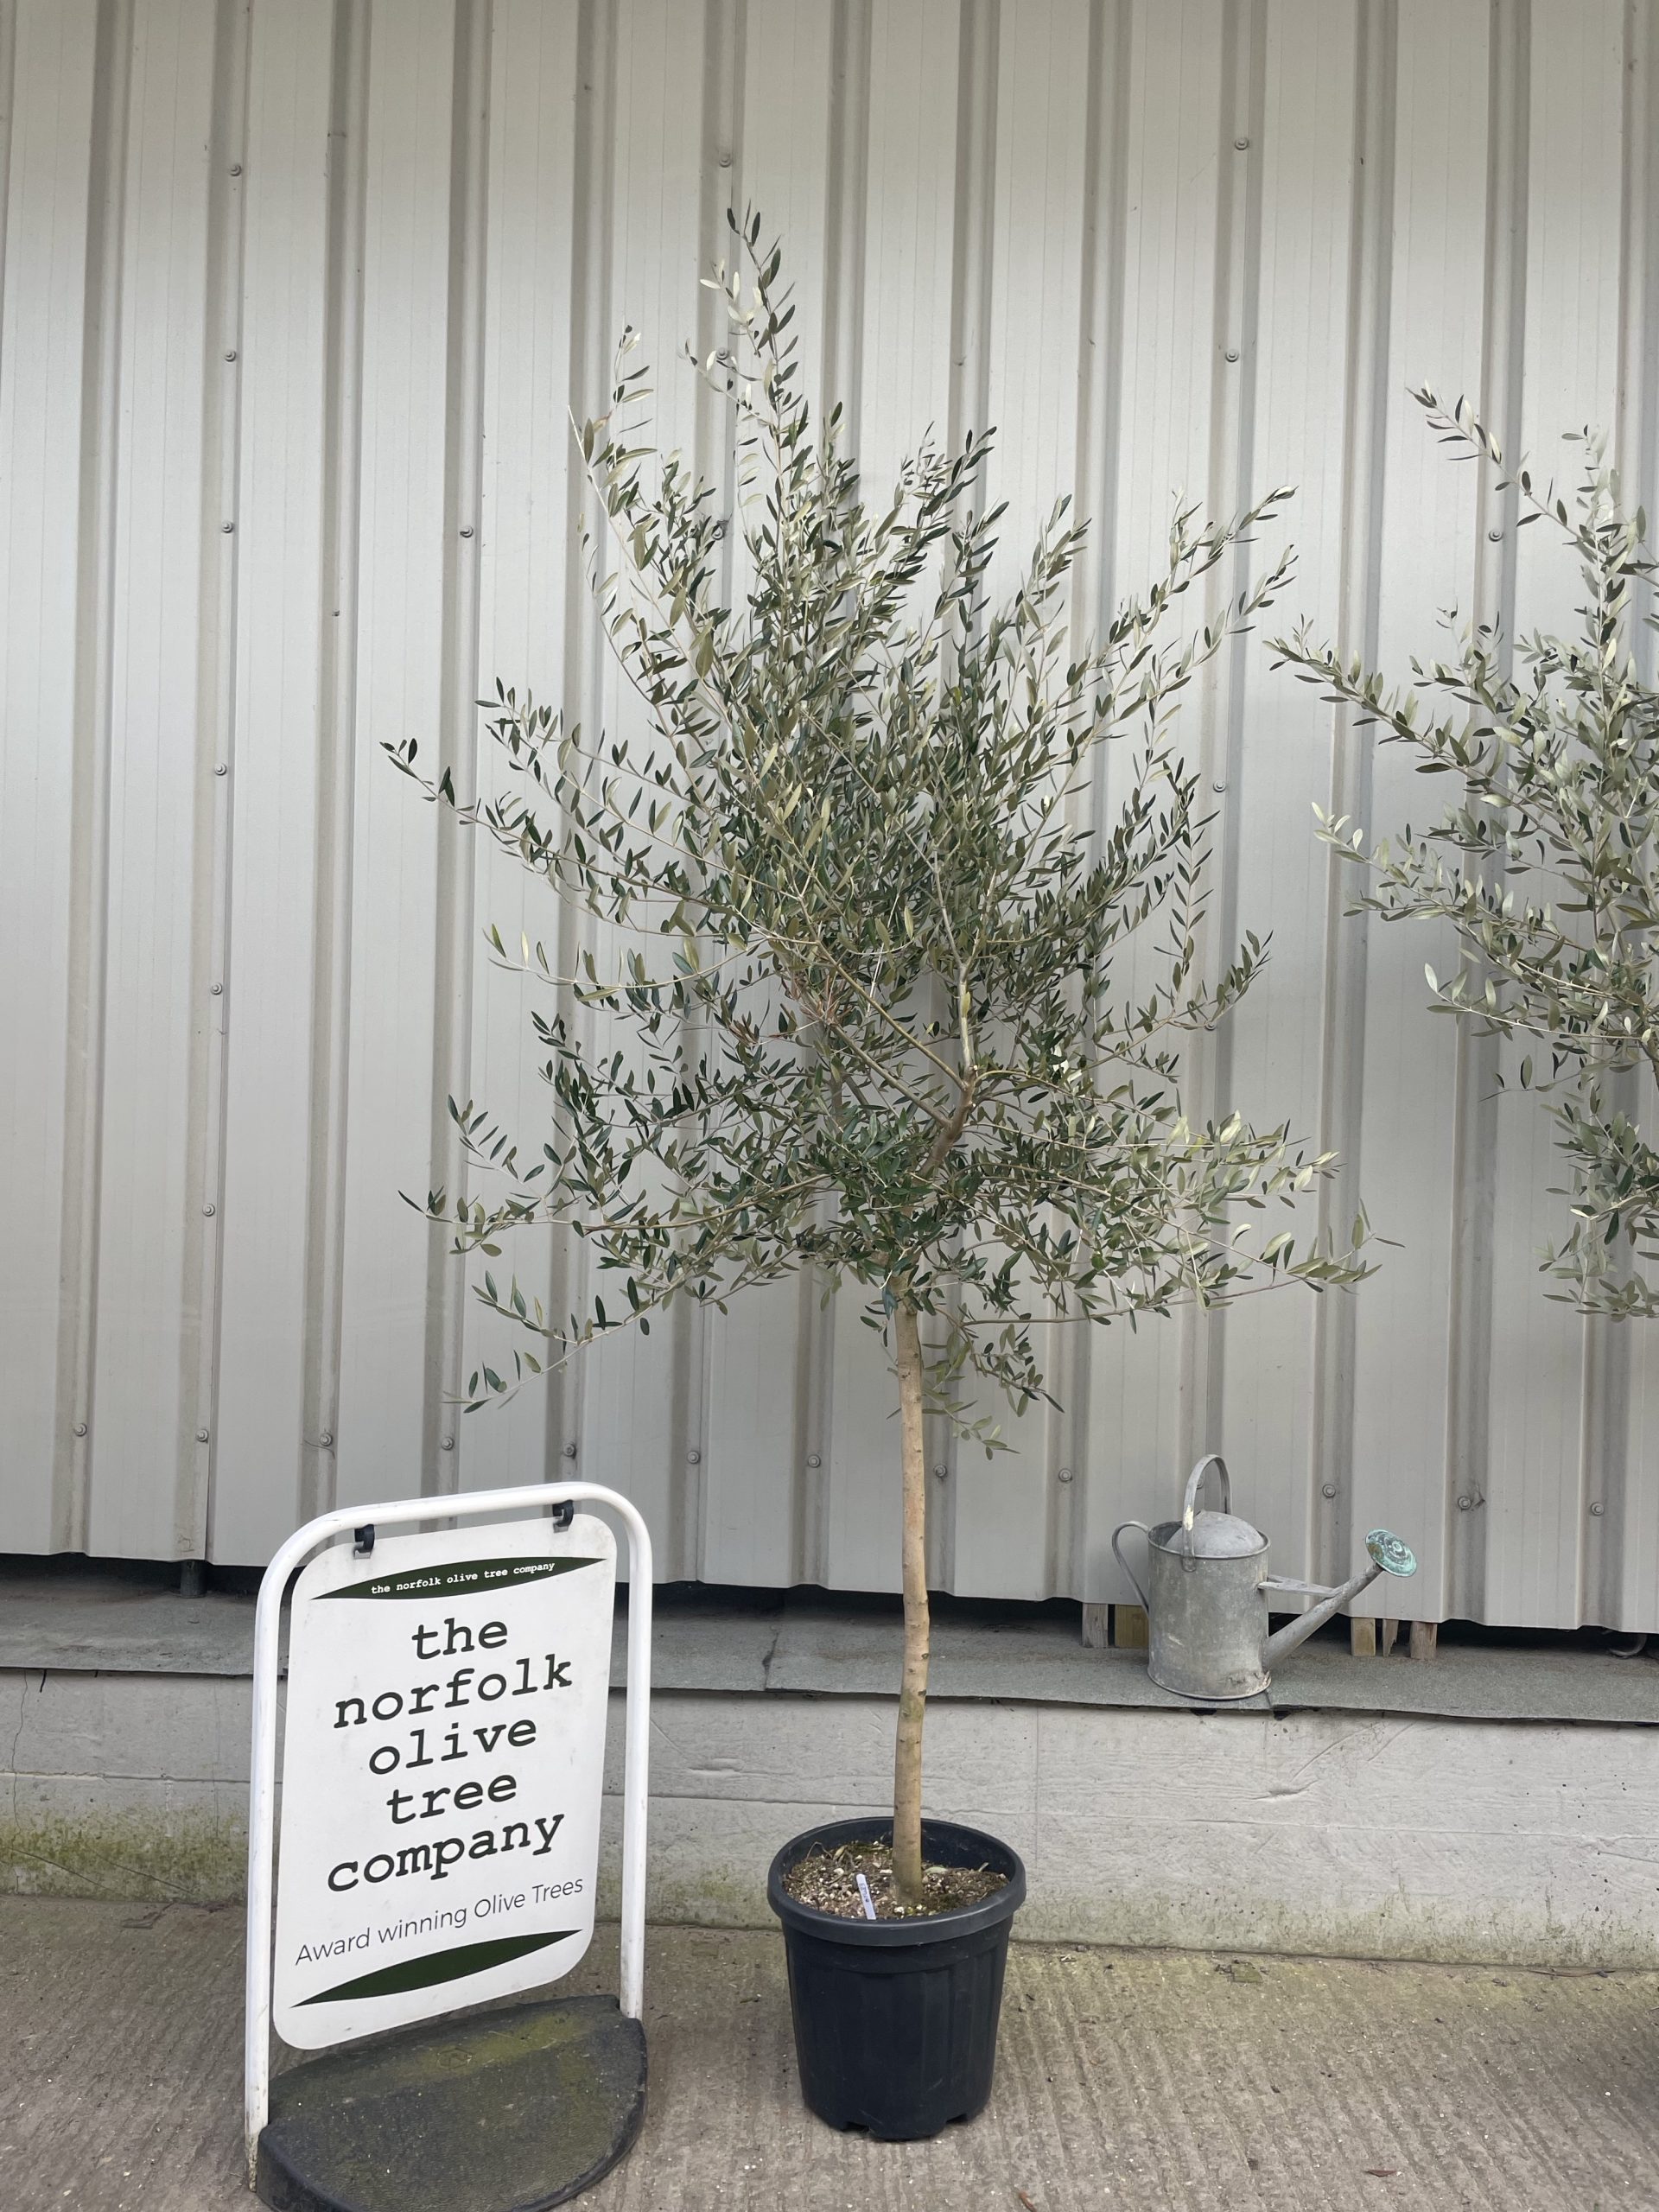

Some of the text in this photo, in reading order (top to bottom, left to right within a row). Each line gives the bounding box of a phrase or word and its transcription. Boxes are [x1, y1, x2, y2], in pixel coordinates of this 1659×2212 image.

[371, 1561, 556, 1594] the norfolk olive tree company
[411, 1617, 508, 1660] the
[334, 1653, 573, 1729] norfolk
[368, 1719, 537, 1776] olive
[385, 1774, 517, 1825] tree
[327, 1814, 565, 1892] company
[295, 1878, 583, 1966] Award winning Olive Trees
